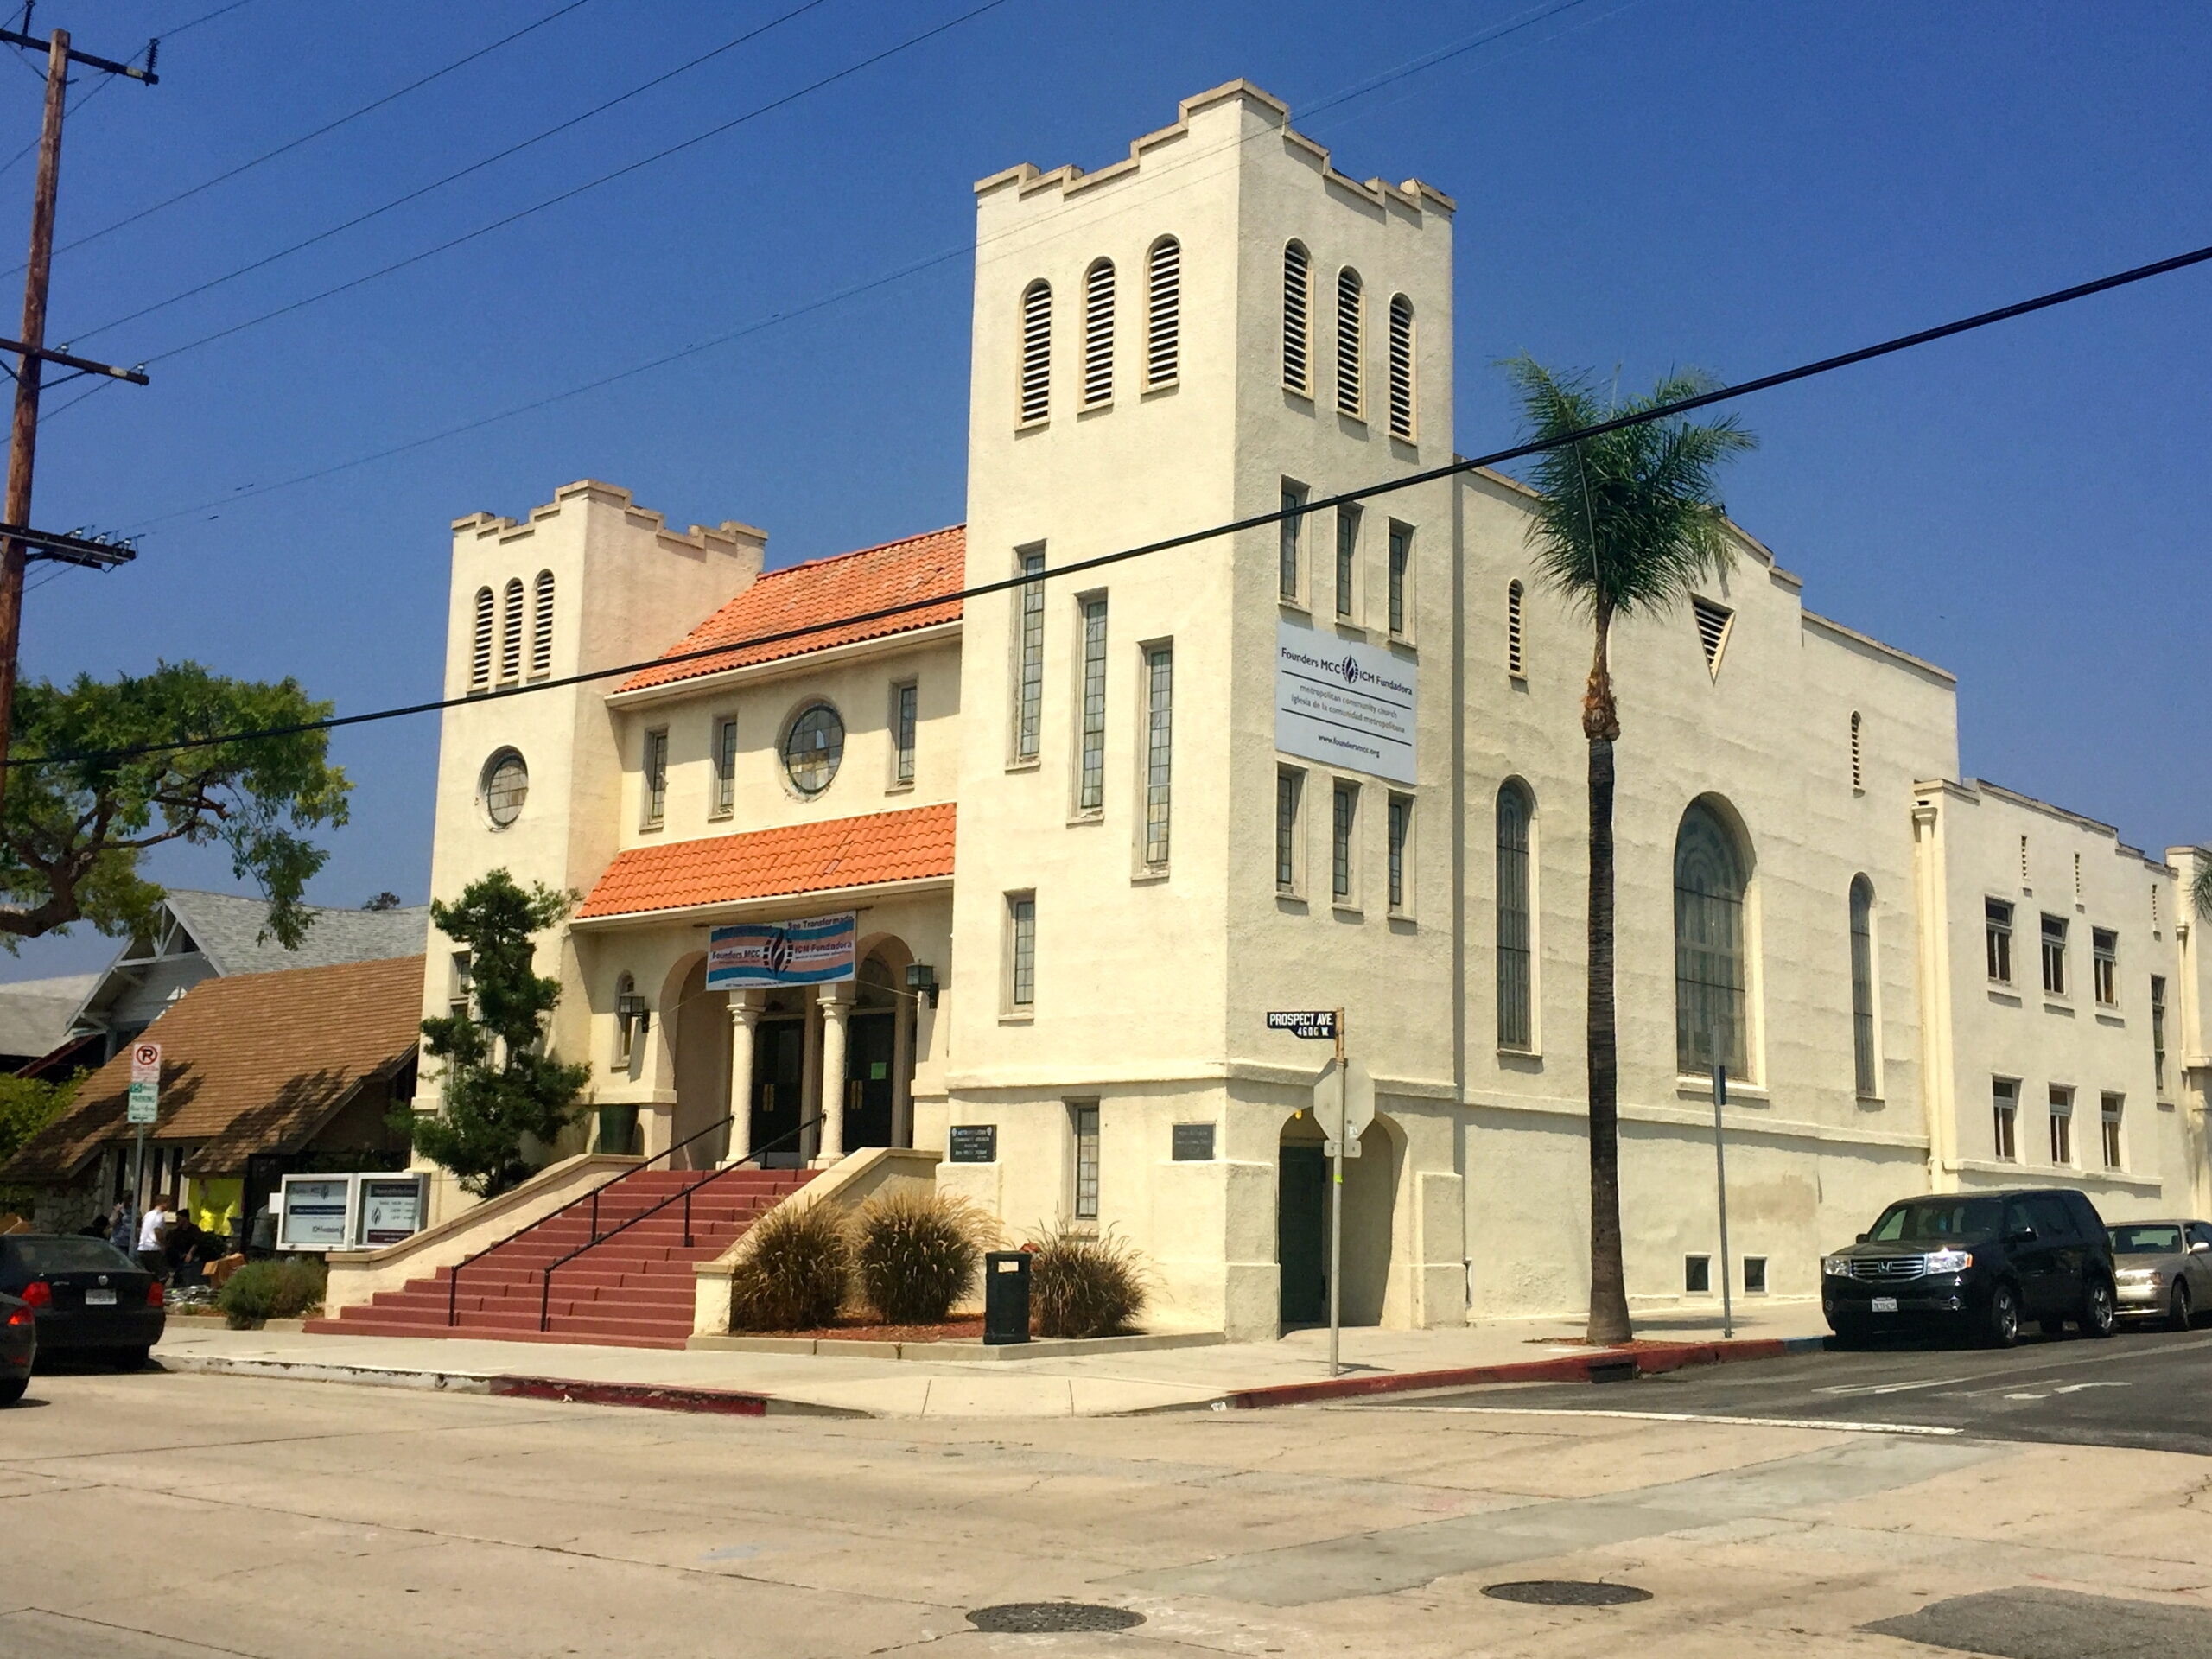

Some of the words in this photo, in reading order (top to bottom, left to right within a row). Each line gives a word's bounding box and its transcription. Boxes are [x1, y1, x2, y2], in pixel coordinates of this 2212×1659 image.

[1281, 647, 1319, 668] Founders
[1320, 659, 1341, 674] MCC
[1359, 671, 1375, 683] ICM
[1376, 676, 1413, 695] Fundadora
[1300, 685, 1341, 702] metropolitan
[1269, 1013, 1314, 1026] PROSPECT
